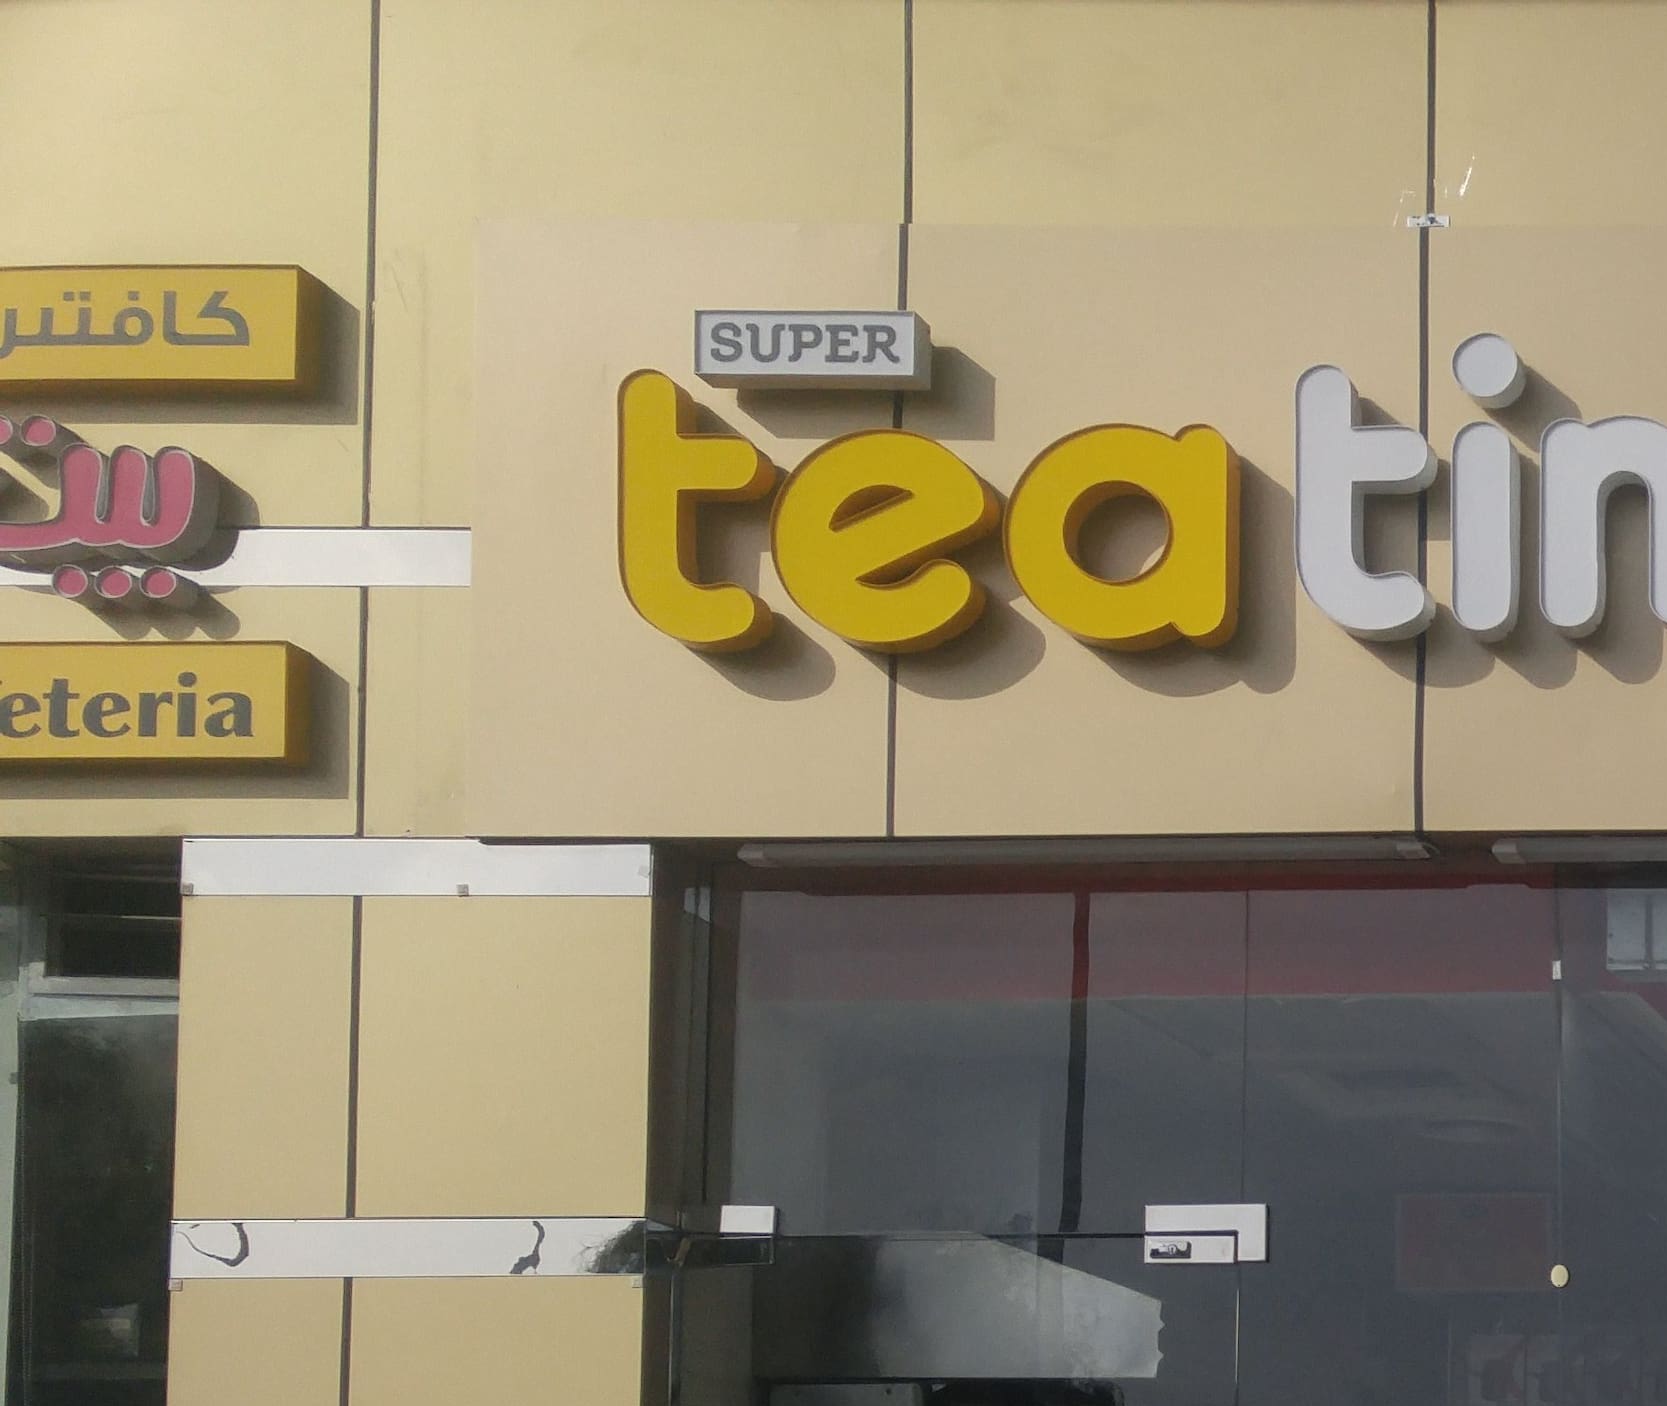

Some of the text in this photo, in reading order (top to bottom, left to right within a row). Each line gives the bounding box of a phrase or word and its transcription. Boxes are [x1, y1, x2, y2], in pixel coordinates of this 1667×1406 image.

[710, 321, 900, 364] SUPER
[619, 368, 1232, 650] tea
[0, 672, 255, 739] eteria
